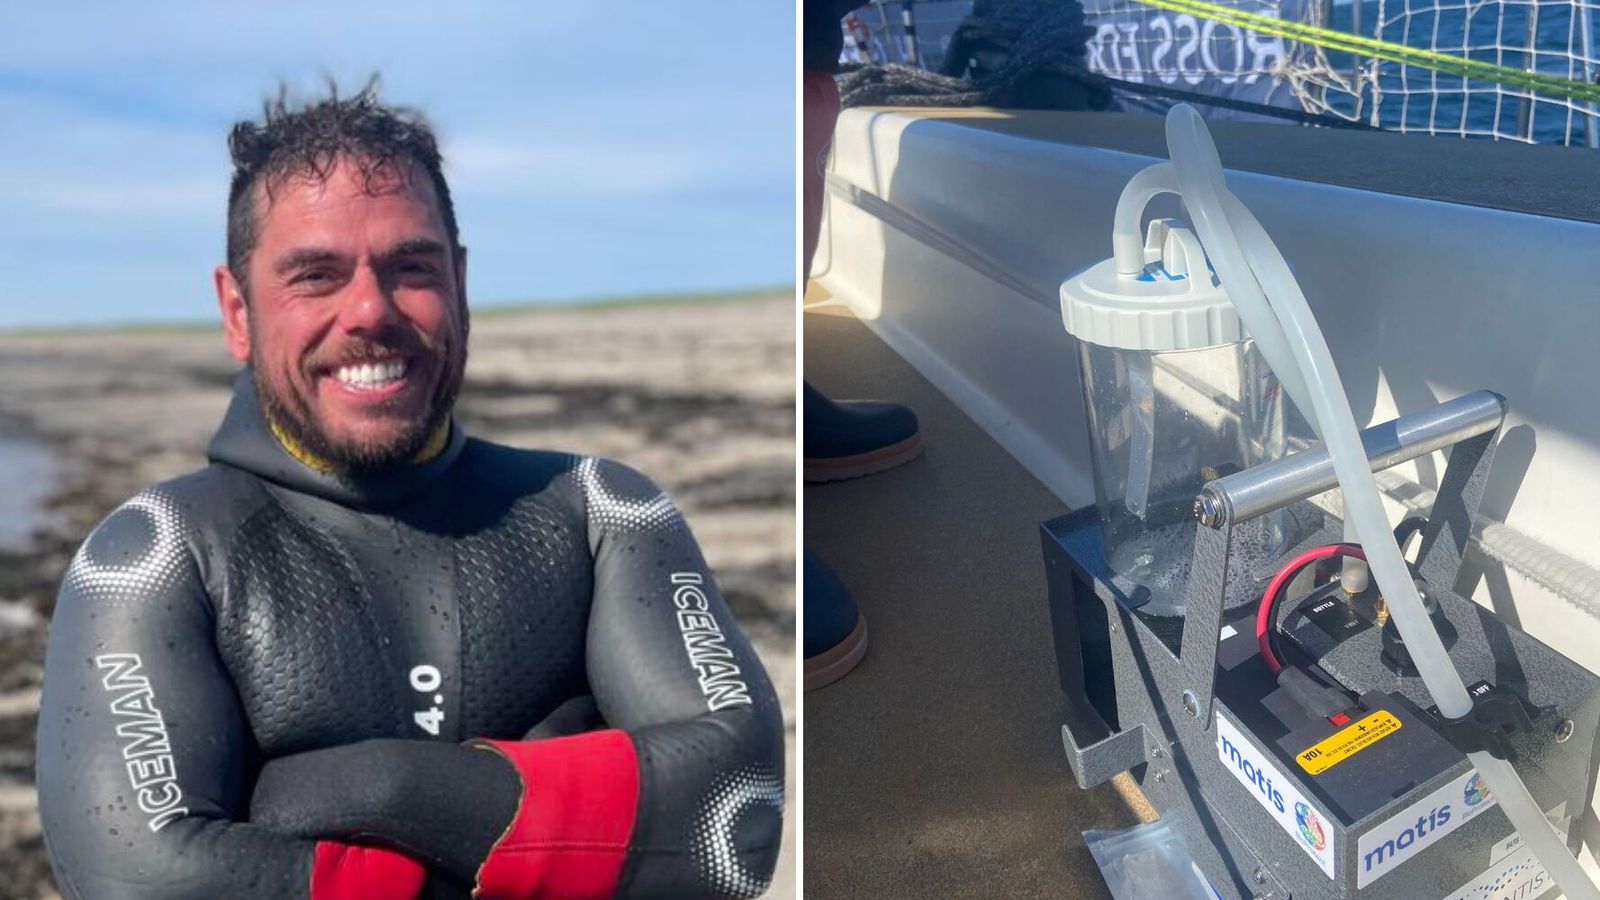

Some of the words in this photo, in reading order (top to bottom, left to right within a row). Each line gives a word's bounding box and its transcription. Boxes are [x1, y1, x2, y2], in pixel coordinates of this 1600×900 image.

[671, 572, 752, 711] ICEMAN
[96, 653, 189, 832] ICEMAN
[409, 664, 444, 735] 4.0
[1302, 748, 1323, 762] 10A
